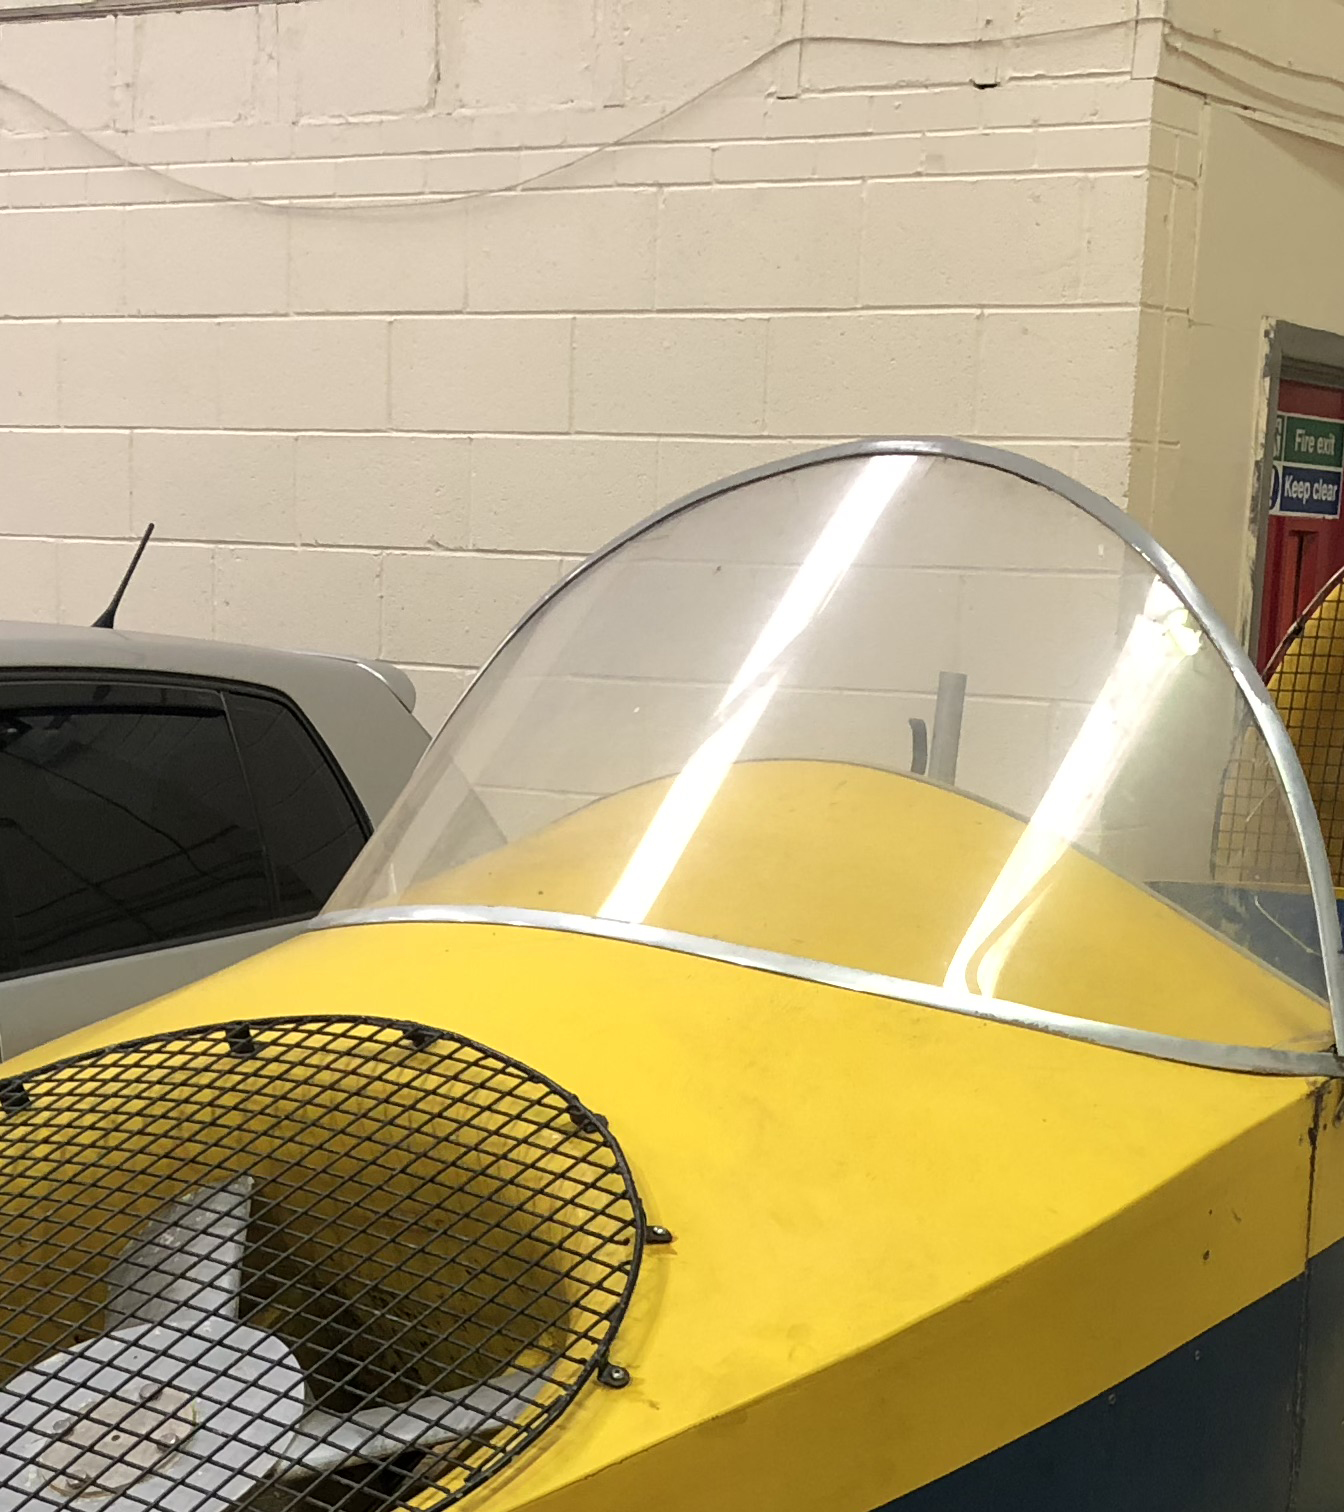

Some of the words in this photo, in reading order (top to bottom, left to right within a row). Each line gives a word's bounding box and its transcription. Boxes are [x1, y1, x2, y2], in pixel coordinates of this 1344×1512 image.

[1295, 428, 1315, 454] Fire
[1316, 433, 1336, 456] exit
[1284, 474, 1310, 504] Keep
[1312, 479, 1338, 503] clear
